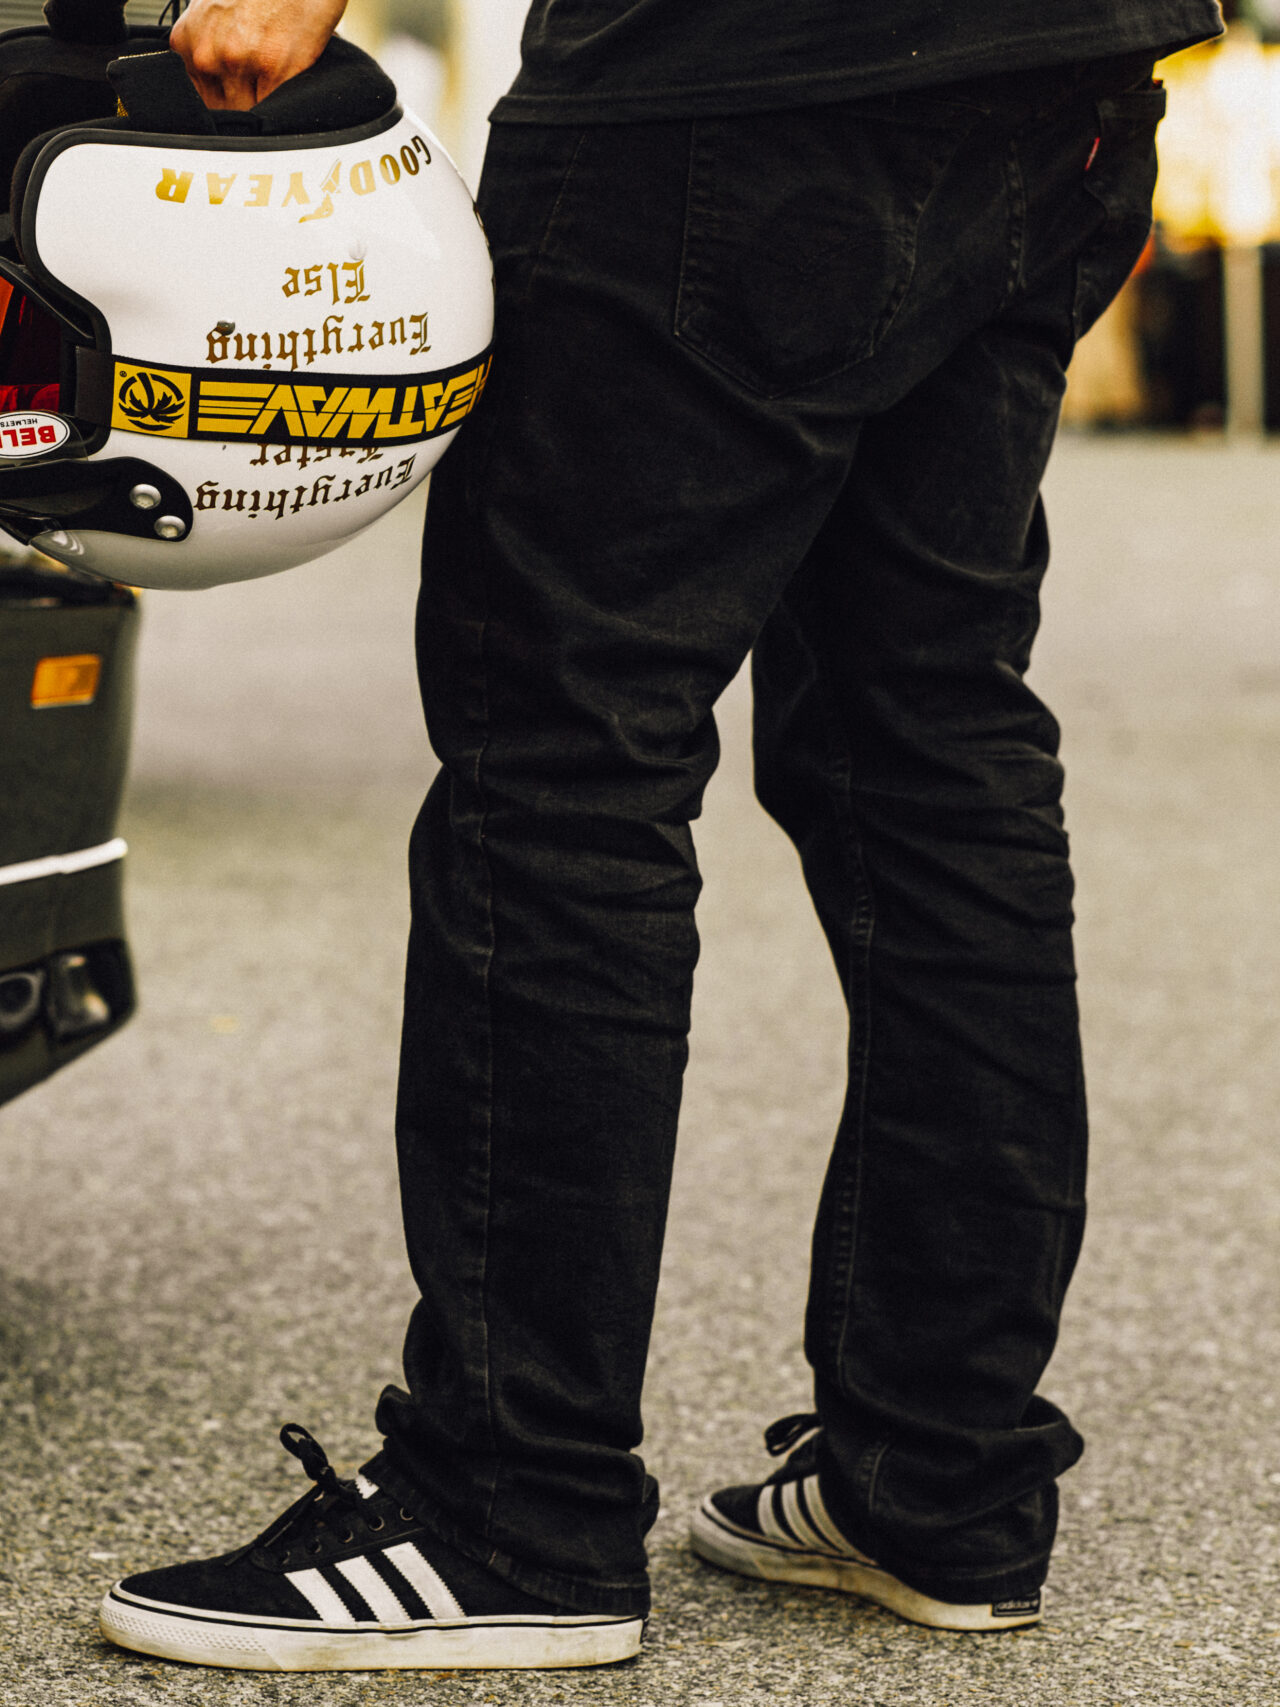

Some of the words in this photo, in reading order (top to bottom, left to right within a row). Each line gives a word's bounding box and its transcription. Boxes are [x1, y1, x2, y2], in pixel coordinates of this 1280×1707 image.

[155, 135, 432, 208] GOODYEAR
[281, 259, 370, 305] Else
[206, 312, 431, 372] Everything
[0, 418, 38, 428] HELMETS
[193, 453, 418, 520] Everything
